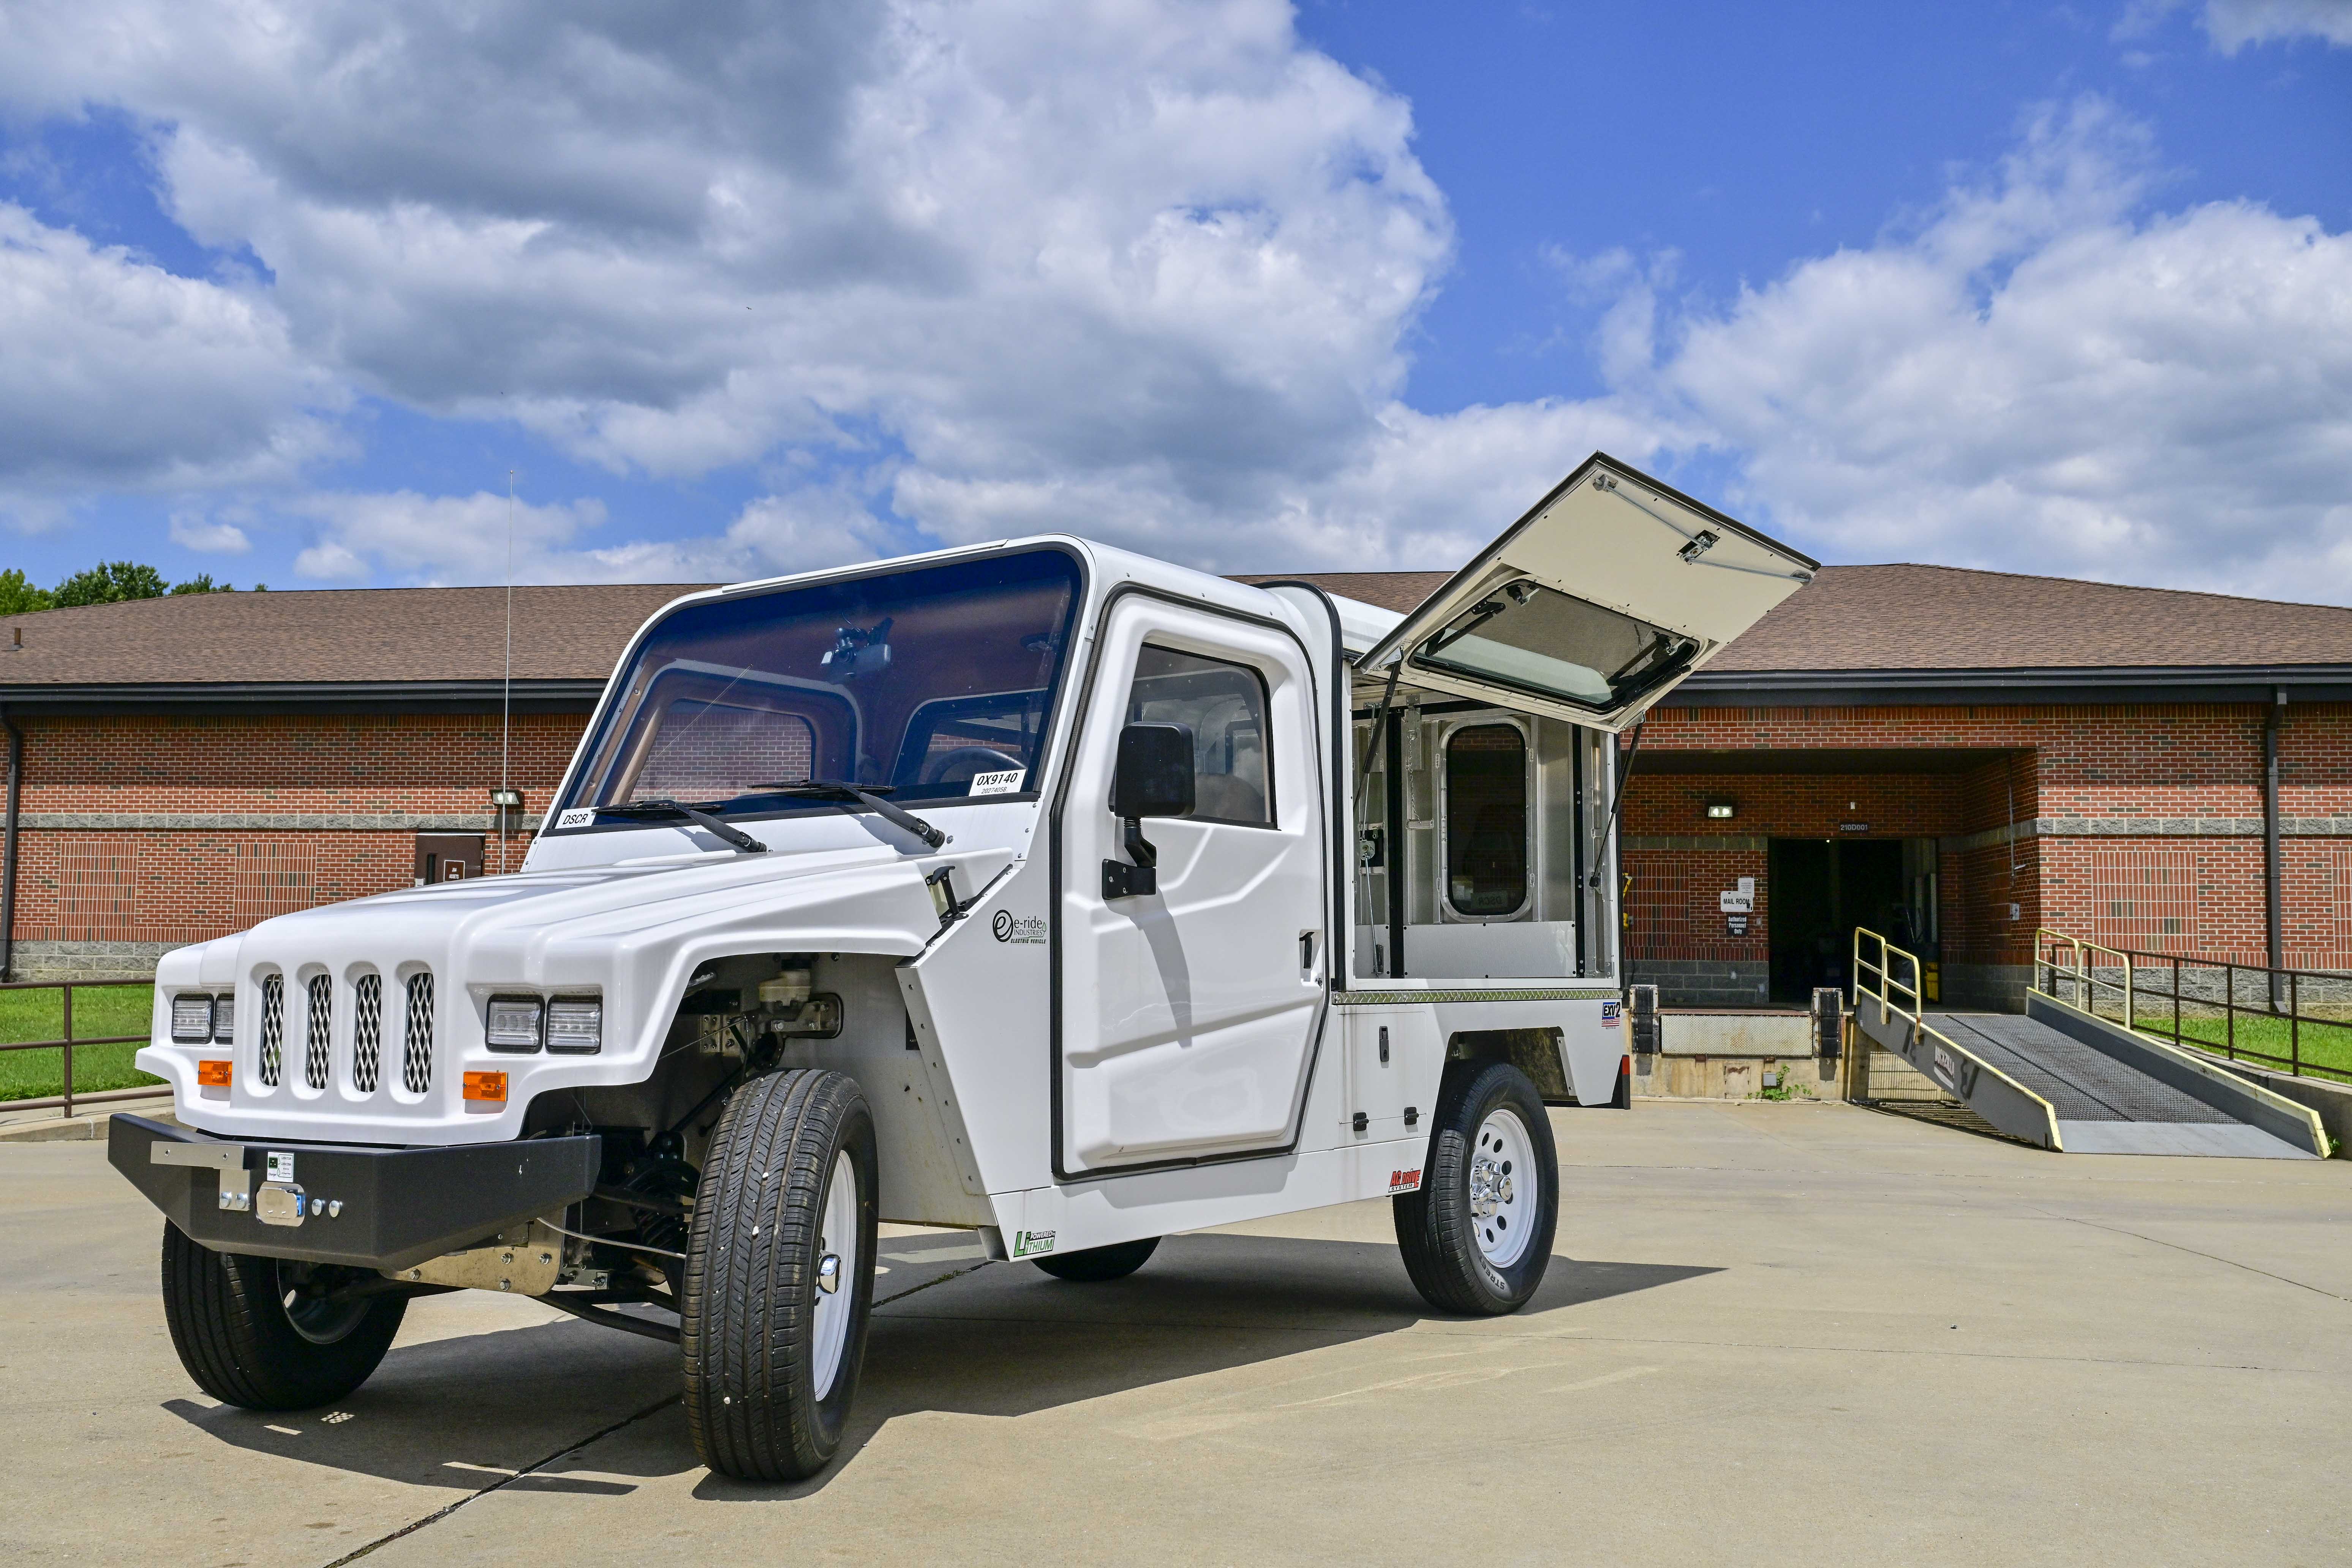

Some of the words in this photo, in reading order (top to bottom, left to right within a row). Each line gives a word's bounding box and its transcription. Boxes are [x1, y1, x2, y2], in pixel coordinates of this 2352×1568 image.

[562, 814, 588, 825] DSCR
[1014, 916, 1042, 929] e-ride
[1390, 1170, 1402, 1186] AC
[1030, 1231, 1052, 1240] POWERED
